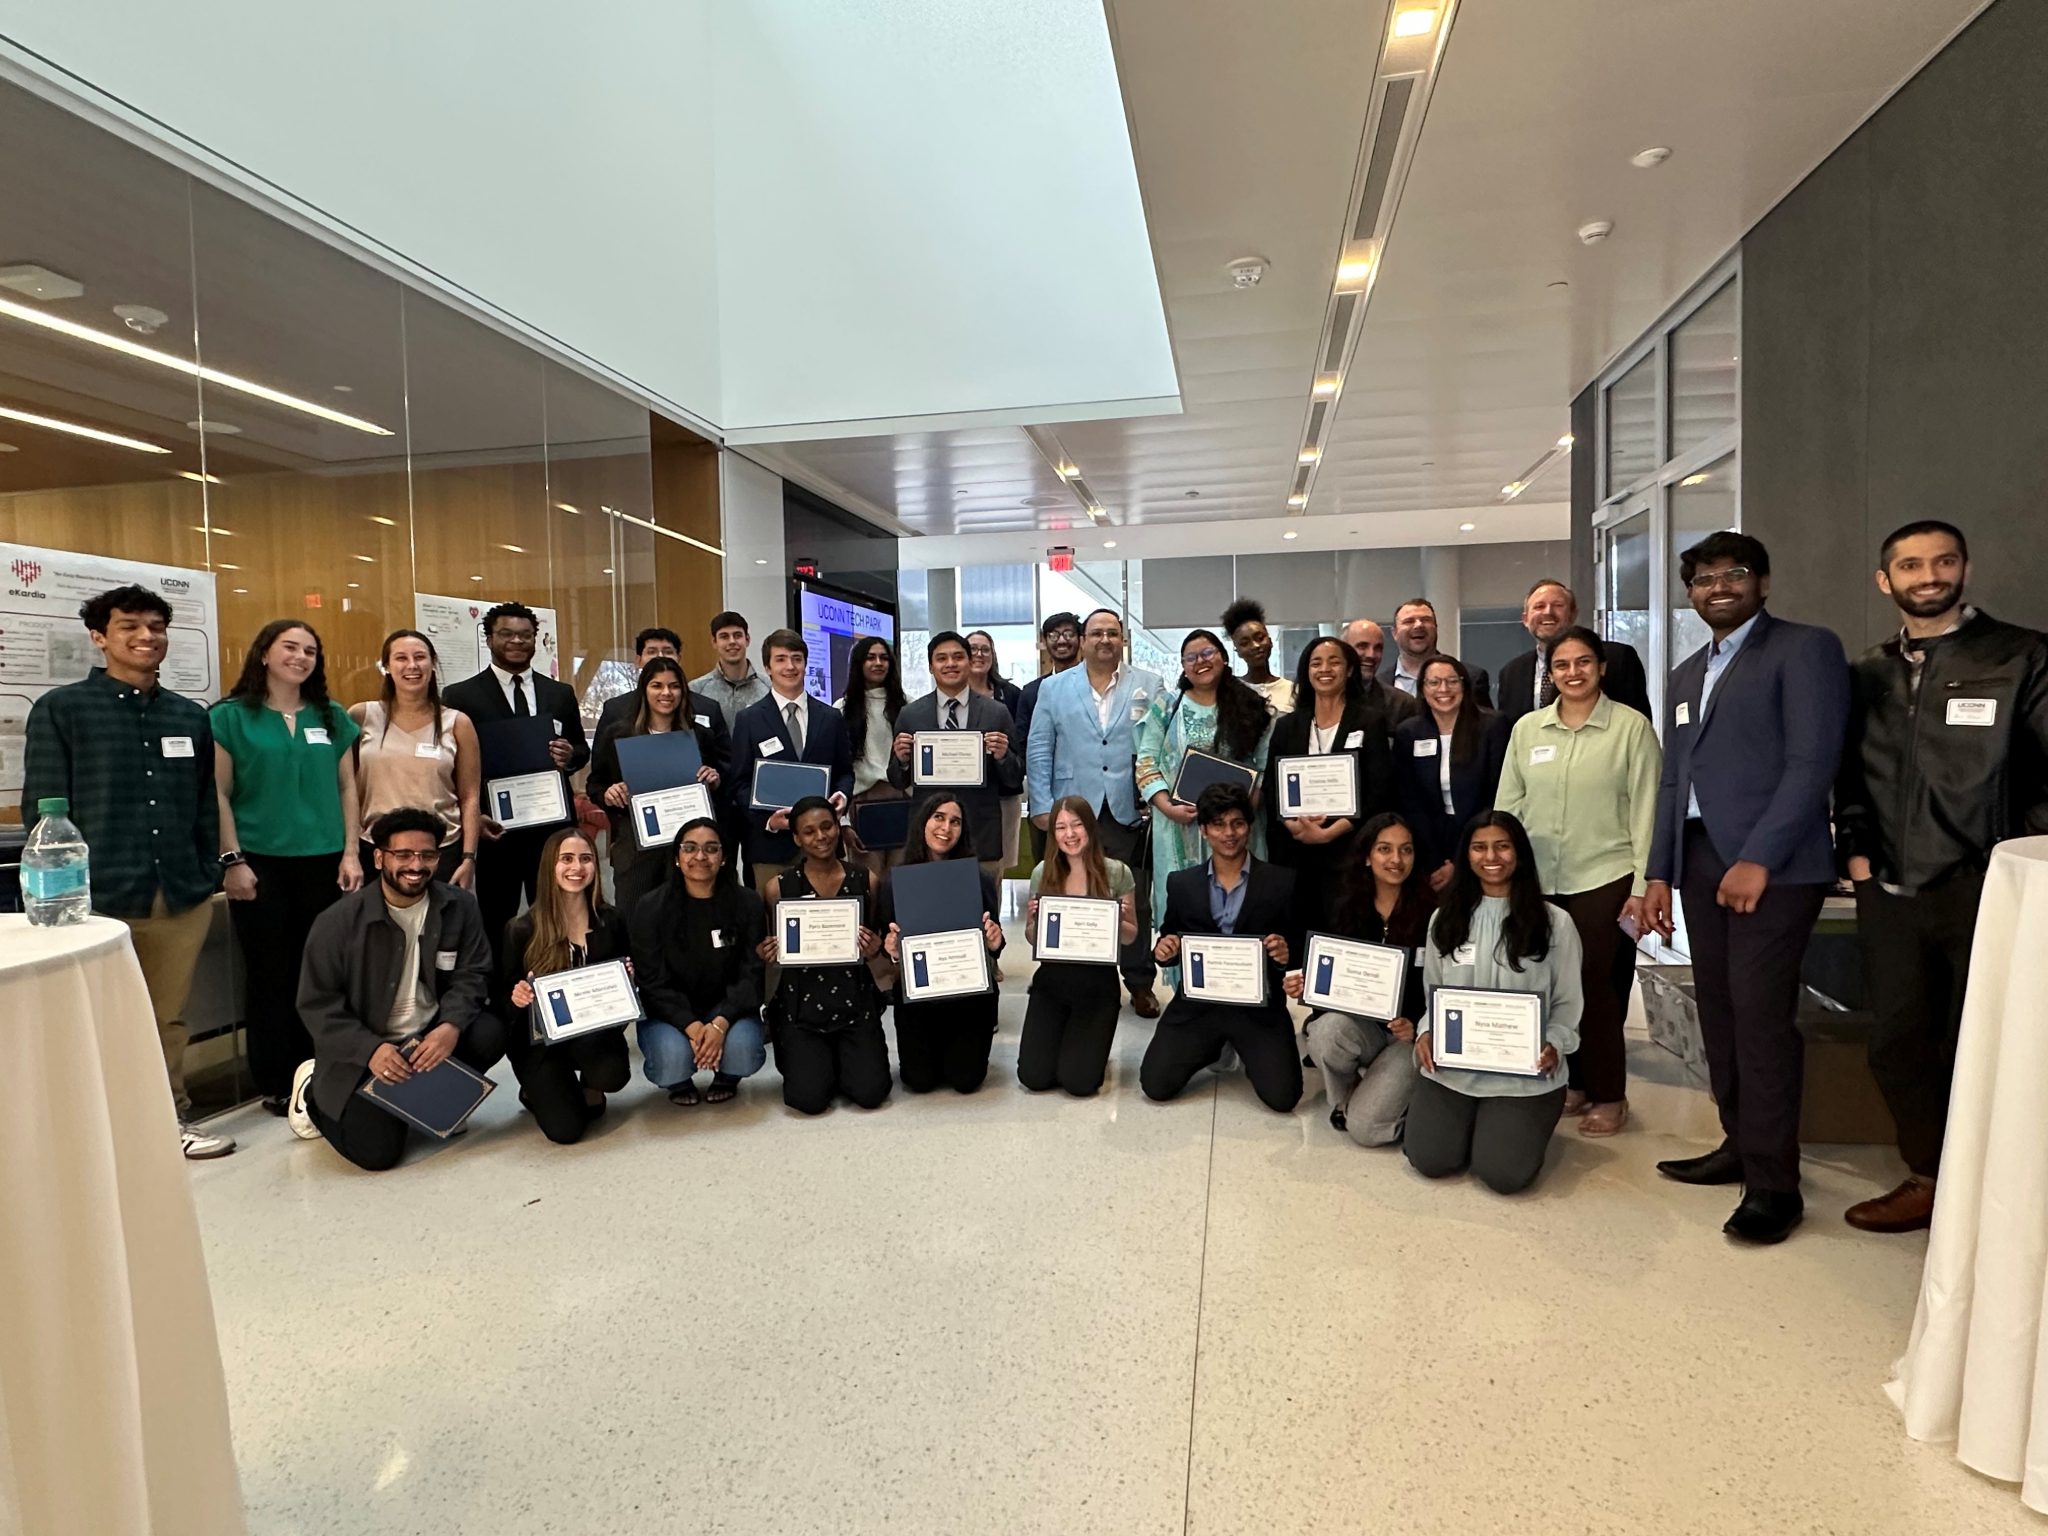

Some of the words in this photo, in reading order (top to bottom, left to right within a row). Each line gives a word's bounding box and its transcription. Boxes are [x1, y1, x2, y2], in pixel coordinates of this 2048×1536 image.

[160, 577, 190, 588] UCONN
[8, 589, 46, 599] eKardia
[818, 602, 845, 624] UCONN
[846, 609, 865, 628] TECH
[866, 615, 882, 632] PARK
